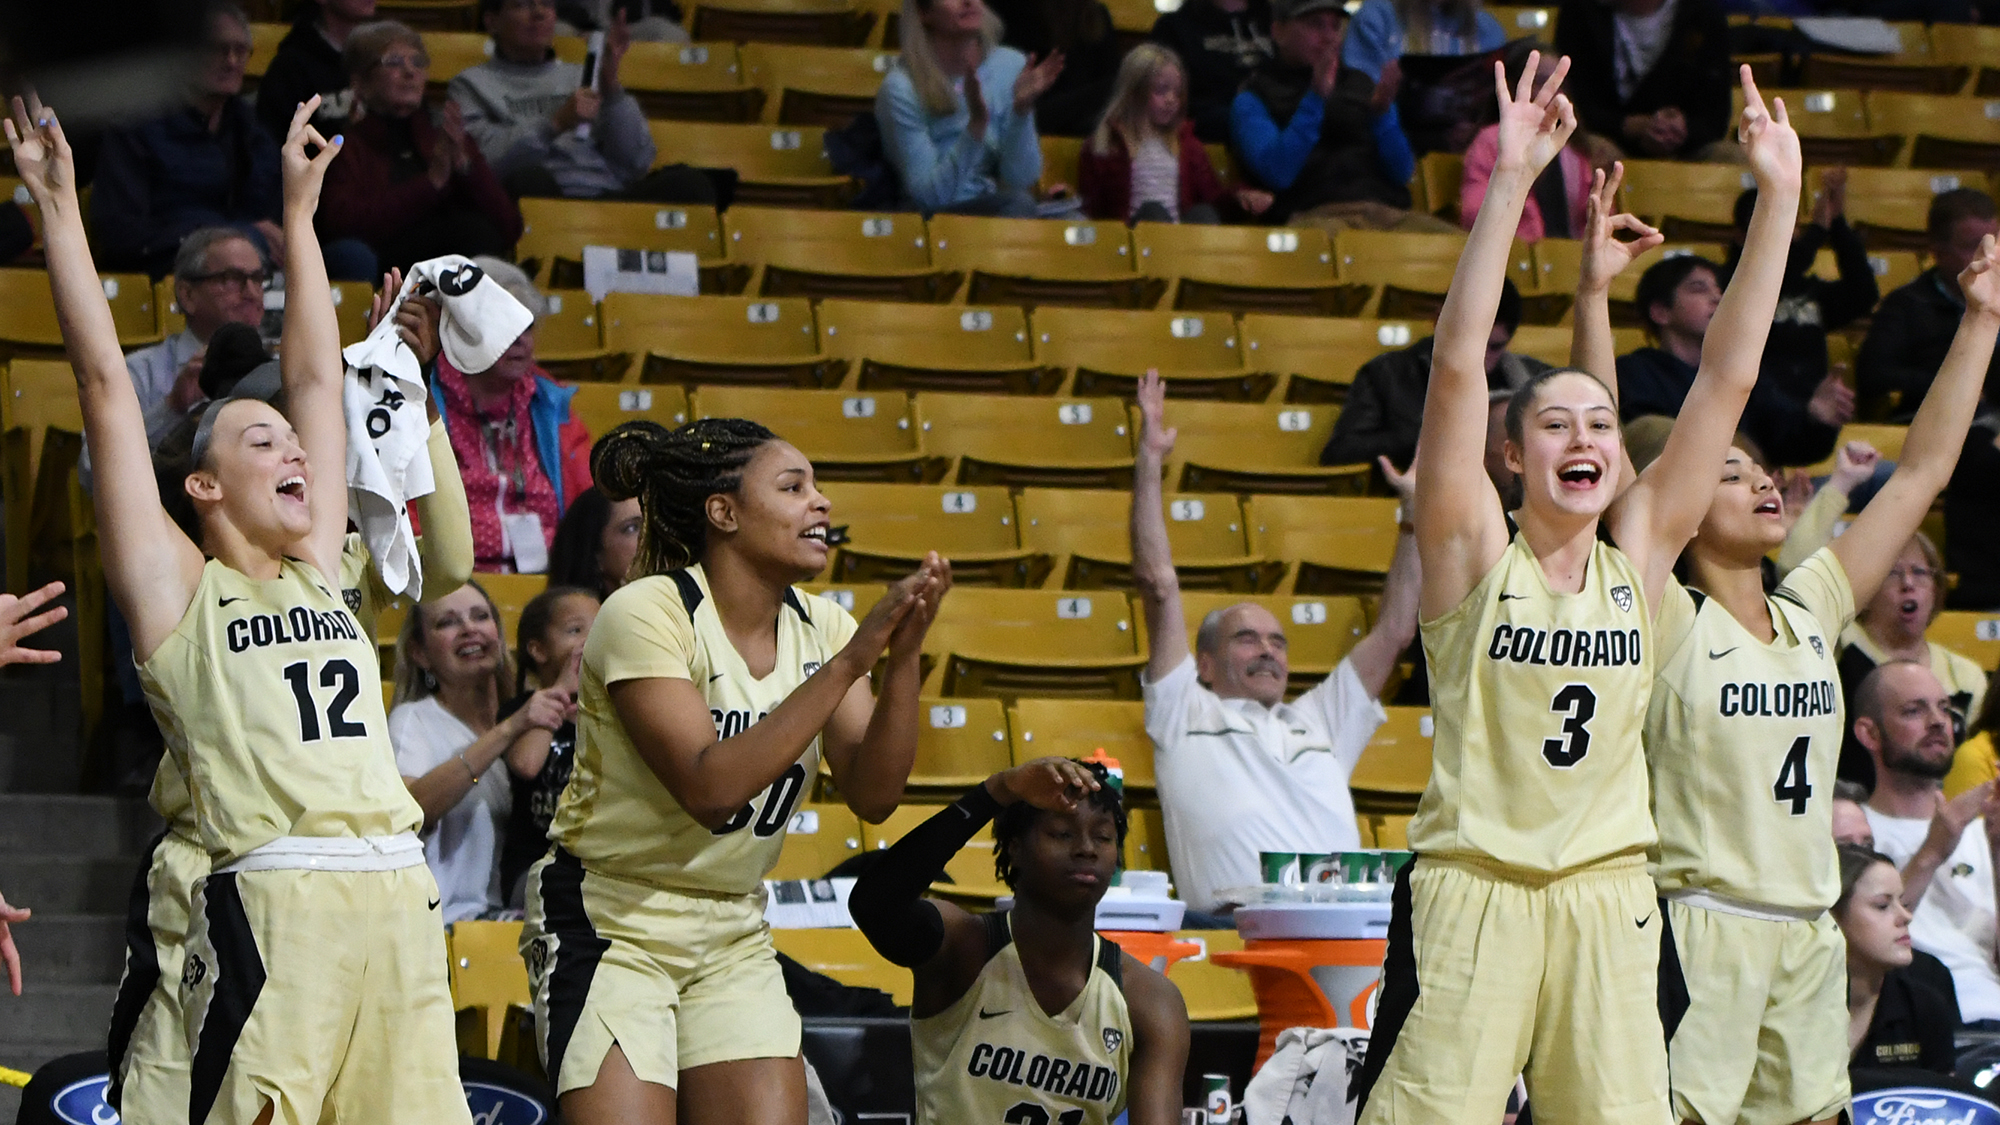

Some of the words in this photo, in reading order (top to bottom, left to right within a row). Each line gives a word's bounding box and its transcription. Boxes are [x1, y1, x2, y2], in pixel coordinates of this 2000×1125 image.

[227, 606, 363, 653] COLORAD
[1488, 624, 1641, 667] COLORADO
[283, 658, 368, 743] 12
[943, 706, 953, 726] 3
[1541, 683, 1597, 769] 3
[1773, 735, 1813, 816] 4
[967, 1042, 1118, 1103] COLORADO
